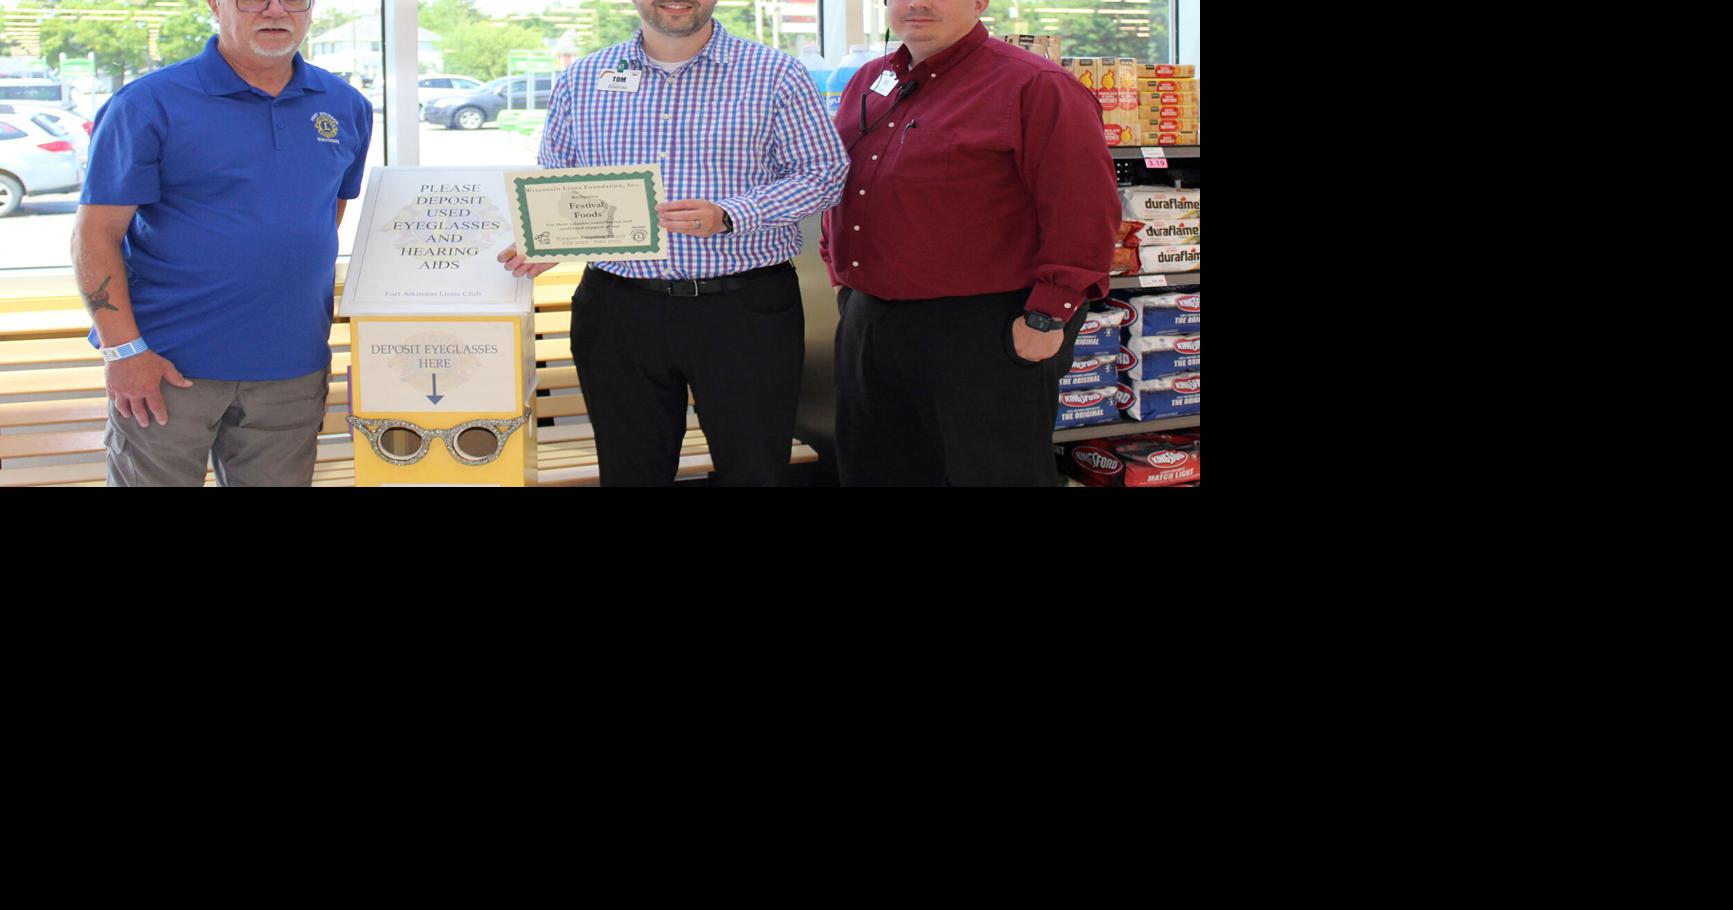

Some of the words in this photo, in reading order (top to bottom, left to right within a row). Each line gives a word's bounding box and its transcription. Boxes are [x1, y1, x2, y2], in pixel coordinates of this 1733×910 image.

[420, 184, 480, 193] PLEASE
[416, 196, 486, 205] DEPOSIT
[569, 201, 604, 209] Festival
[1145, 198, 1200, 210] duraflame
[427, 209, 471, 217] USED
[574, 210, 602, 218] Foods
[393, 221, 500, 230] EYEGLASSES
[1146, 226, 1199, 236] duraflame
[425, 234, 463, 243] AND
[400, 247, 479, 256] HEARING
[1158, 251, 1200, 263] duraflam
[418, 261, 460, 270] AIDS
[371, 344, 421, 355] DEPOSIT
[424, 344, 498, 355] EYEGLASSES
[418, 358, 451, 369] HERE
[1061, 411, 1074, 421] THE
[1074, 409, 1104, 419] ORIGINAL
[1075, 451, 1119, 470] KINGSFORD
[1174, 467, 1195, 479] LIGHT
